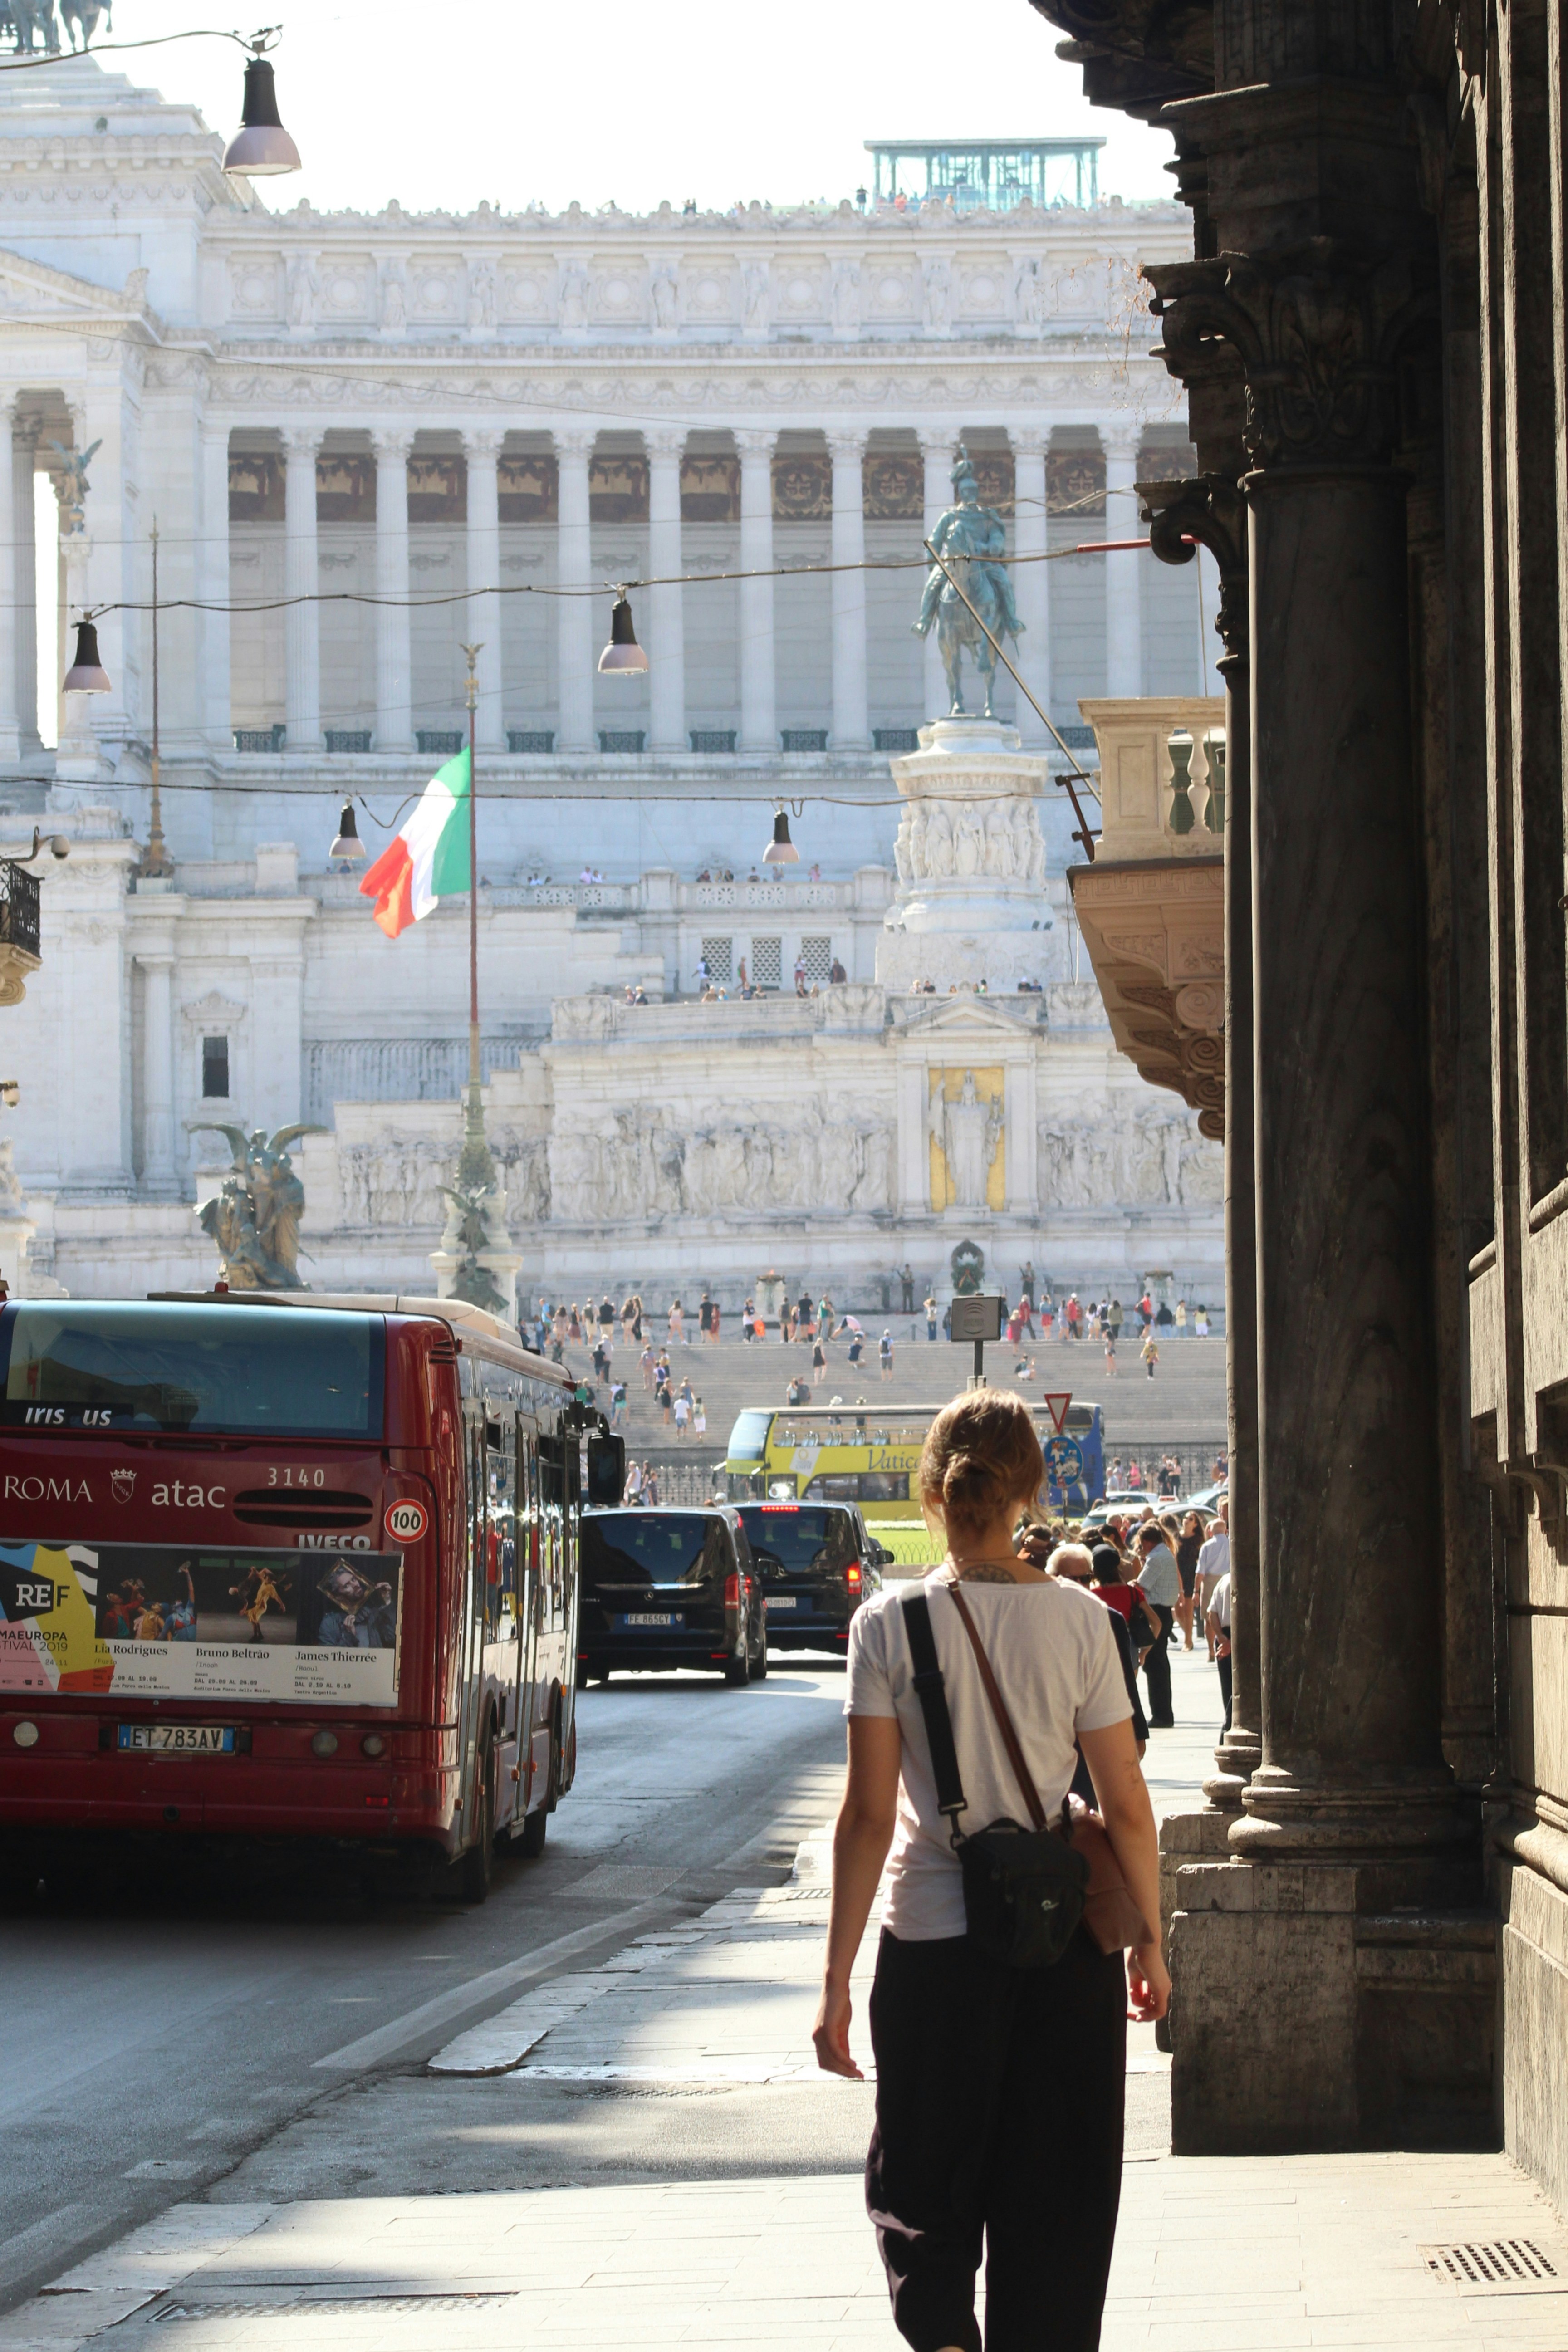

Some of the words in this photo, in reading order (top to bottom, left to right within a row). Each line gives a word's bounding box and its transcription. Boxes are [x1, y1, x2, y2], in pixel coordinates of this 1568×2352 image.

[25, 1407, 65, 1425] iris
[83, 1410, 112, 1426] us
[268, 1467, 325, 1487] 3140
[5, 1476, 93, 1502] ROMA
[152, 1480, 225, 1508] atac
[393, 1511, 421, 1530] 100
[299, 1534, 371, 1550] IVECO
[16, 1584, 70, 1607] REF
[629, 1615, 640, 1624] FE
[0, 1640, 36, 1651] TIVAL
[39, 1642, 68, 1651] 2019
[94, 1644, 110, 1653] Lia
[113, 1644, 168, 1657] Rodrigues
[196, 1648, 229, 1657] Bruno
[232, 1648, 270, 1659] Beltrão
[295, 1651, 329, 1661] James
[331, 1651, 377, 1662] Thierrée
[133, 1728, 156, 1746] ET
[162, 1728, 221, 1749] 783AV
